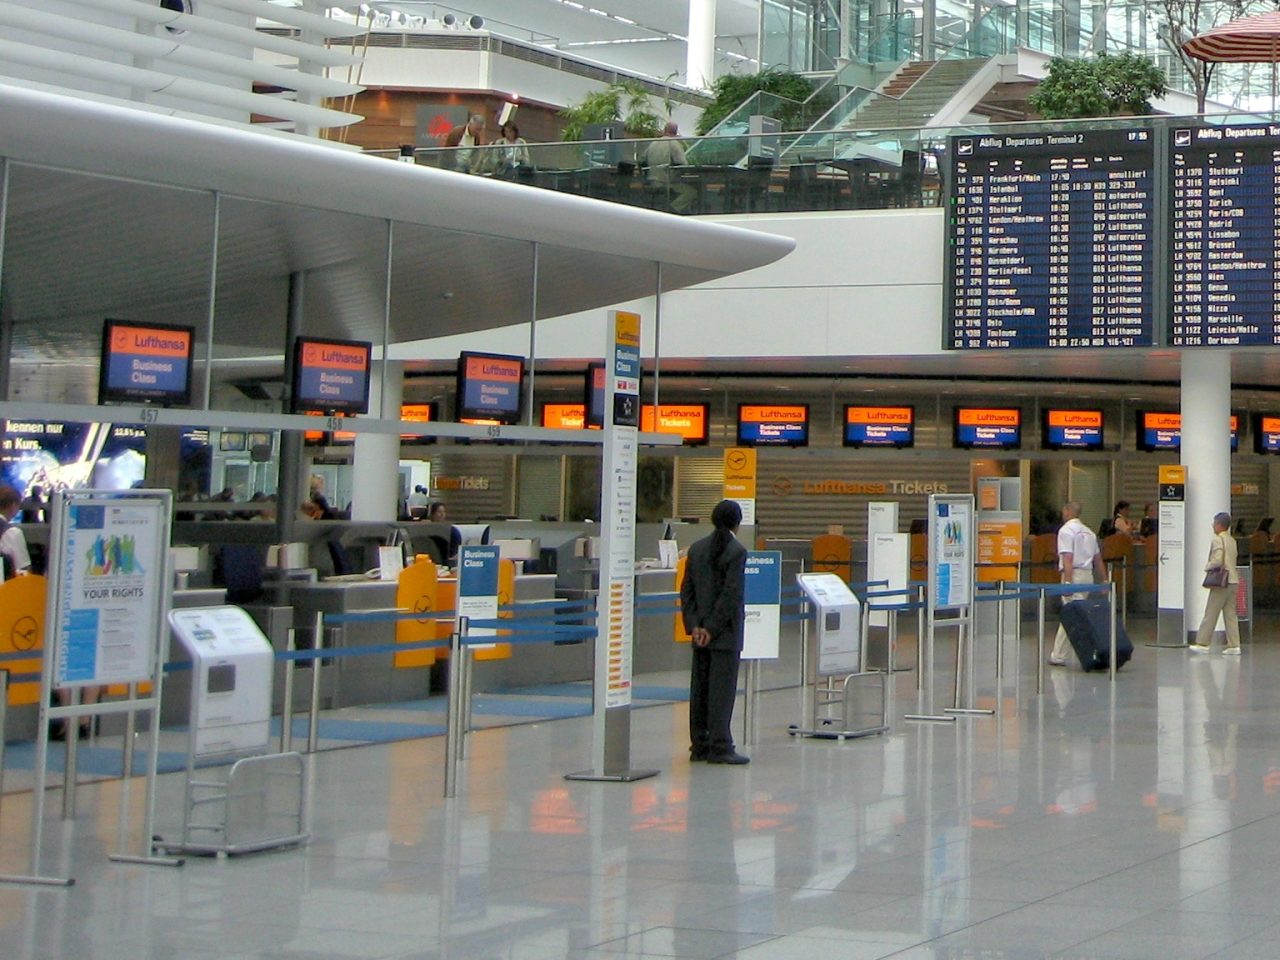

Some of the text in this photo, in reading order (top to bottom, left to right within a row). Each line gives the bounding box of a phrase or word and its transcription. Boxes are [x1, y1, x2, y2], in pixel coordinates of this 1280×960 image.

[1198, 129, 1221, 139] Abflug
[1226, 128, 1265, 137] Departures
[980, 135, 1083, 148] Abflug Departures Terminal 2
[989, 174, 1041, 183] Frankfurt/Main
[990, 185, 1018, 193] Istanbul
[1209, 198, 1232, 207] Zürich
[989, 215, 1044, 224] London/Heathrow
[988, 329, 1017, 337] Toulouse
[135, 333, 185, 352] Lufthansa
[321, 351, 365, 365] Lufthansa
[132, 358, 172, 372] Business
[482, 363, 518, 377] Lufthansa
[131, 372, 156, 384] Class
[320, 372, 354, 384] Business
[319, 383, 340, 395] Class
[480, 384, 509, 395] Business
[480, 394, 497, 405] Class
[139, 409, 158, 423] 457
[867, 412, 908, 420] Lufthansa
[977, 413, 1015, 422] Lufthansa
[6, 420, 64, 433] kennen nur
[327, 418, 343, 431] 458
[15, 438, 42, 449] Kurs.
[803, 479, 948, 495] Lufthansa Tickets
[464, 550, 495, 559] Business
[464, 560, 484, 568] Class
[83, 588, 144, 599] YOUR RIGHTS
